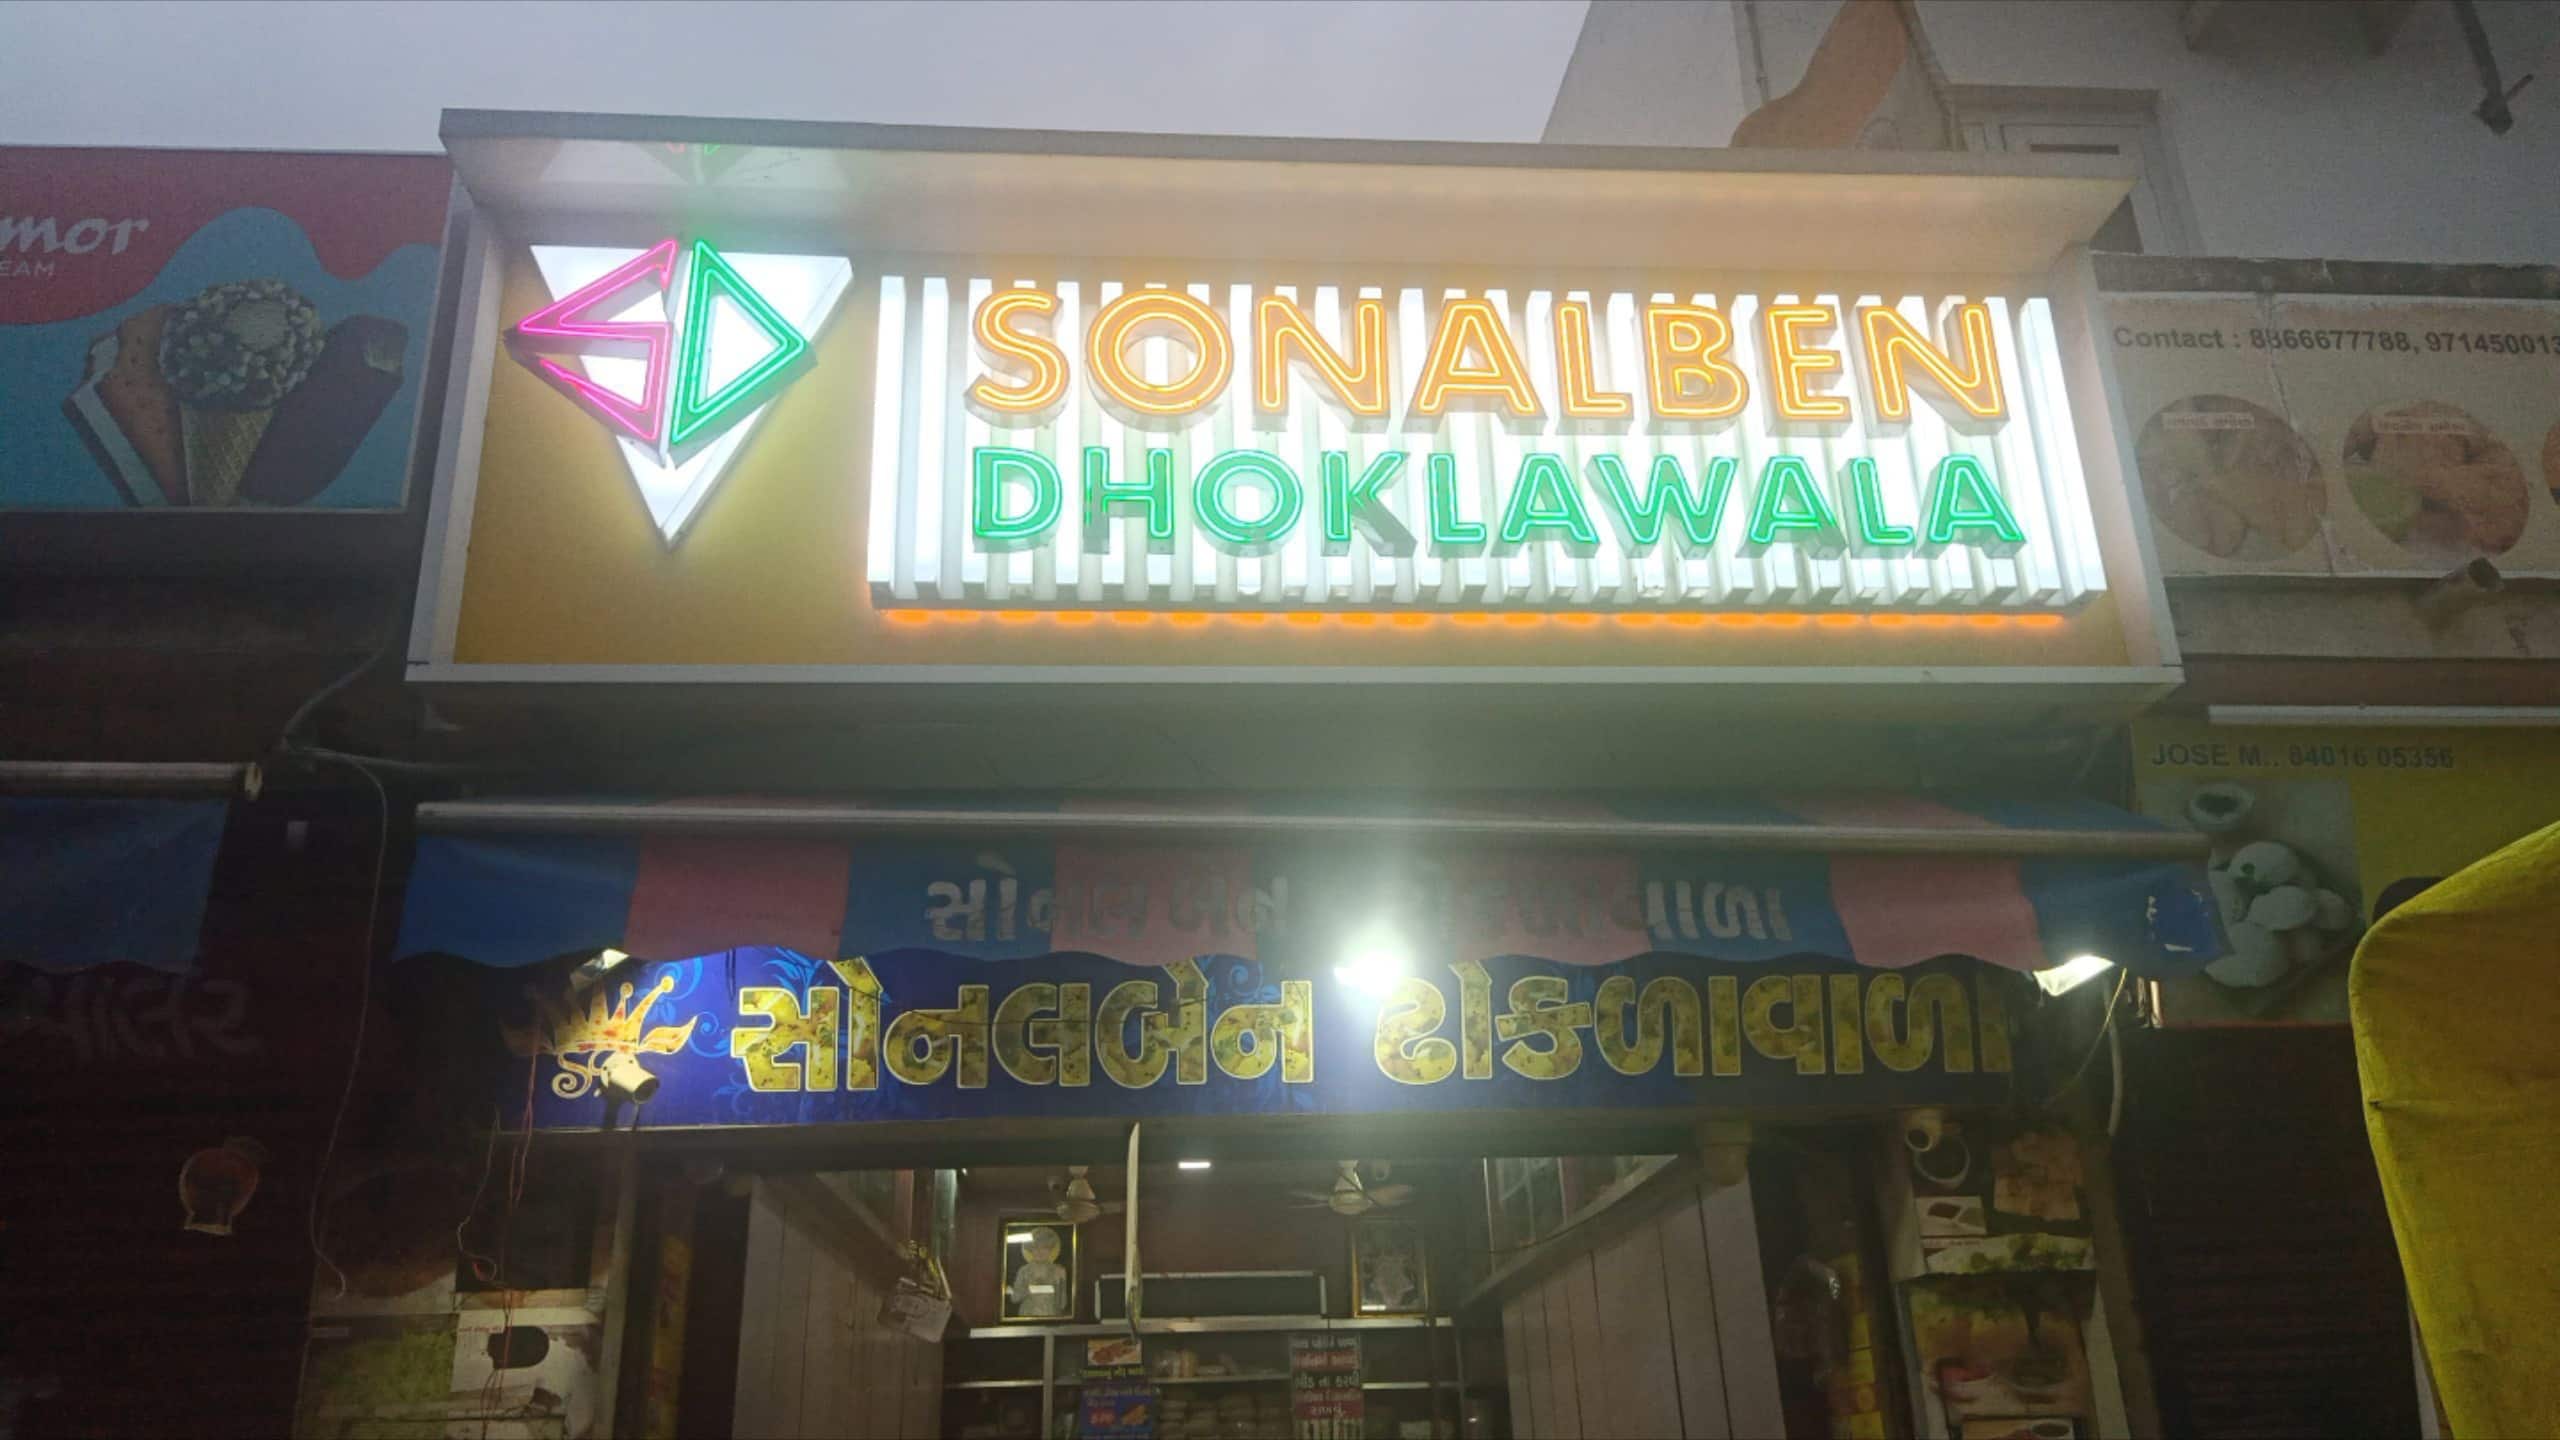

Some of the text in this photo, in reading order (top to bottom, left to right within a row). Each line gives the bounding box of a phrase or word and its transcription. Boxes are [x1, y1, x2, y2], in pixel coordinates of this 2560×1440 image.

[965, 289, 2010, 425] SONALBEN
[2114, 327, 2225, 350] Contact
[972, 446, 2026, 552] DHOKLAWALA
[2152, 743, 2230, 766] JOSE
